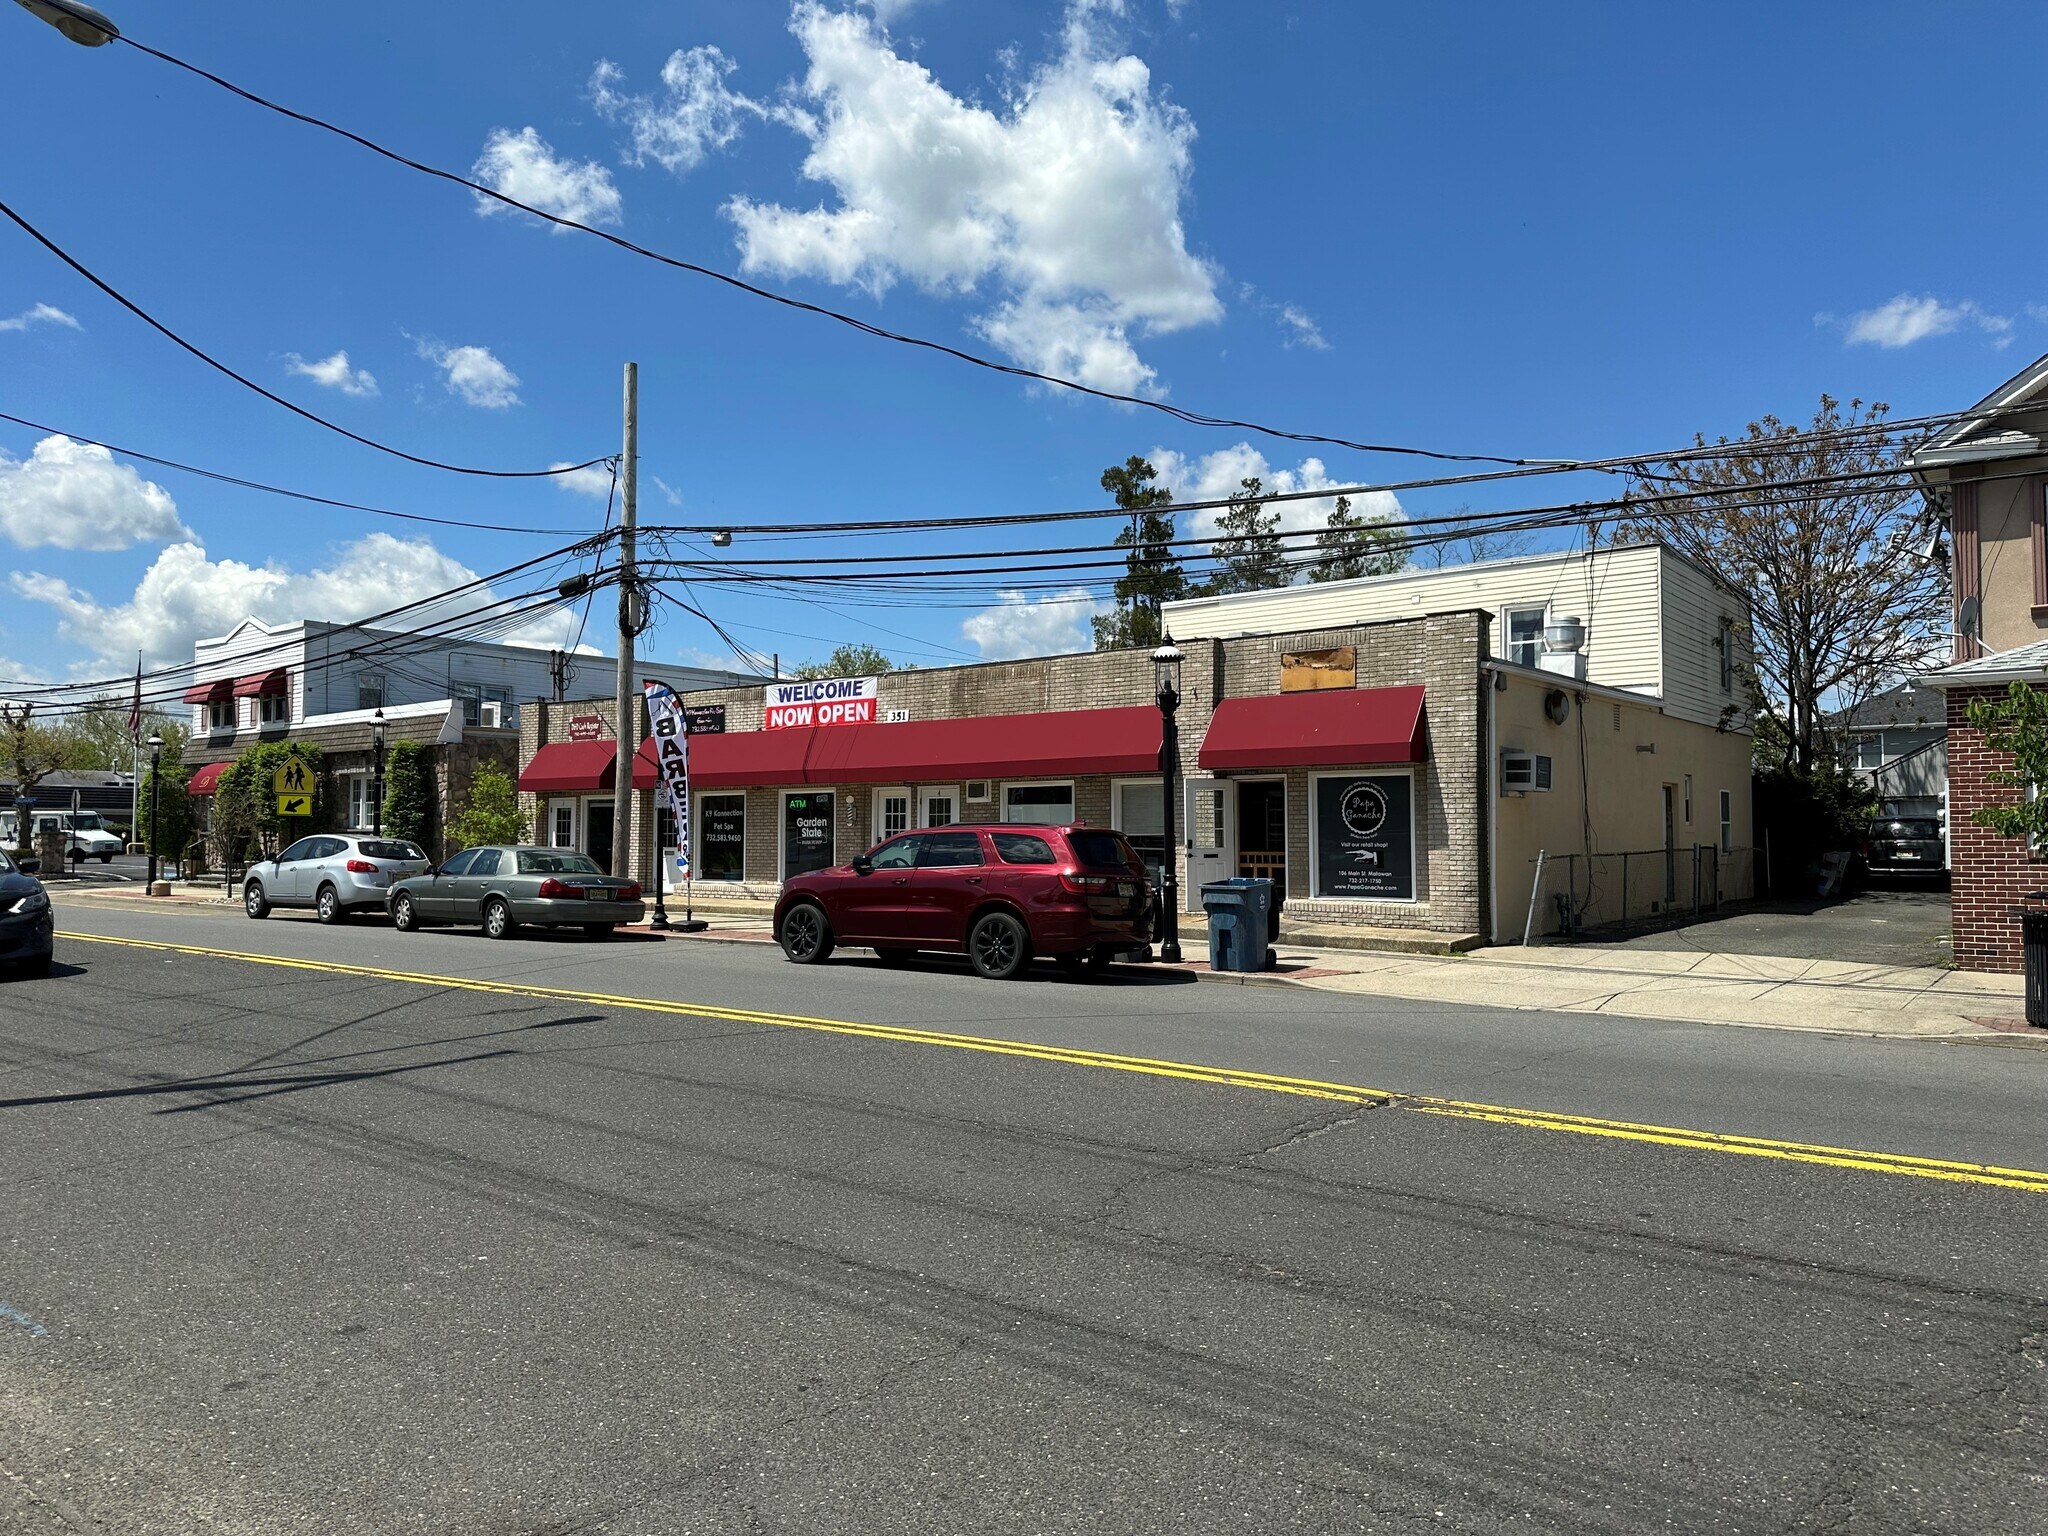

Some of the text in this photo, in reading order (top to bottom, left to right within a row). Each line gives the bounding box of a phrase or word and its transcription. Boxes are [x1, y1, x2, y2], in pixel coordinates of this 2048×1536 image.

[778, 681, 863, 702] WELCOME
[770, 702, 869, 728] NOW OPEN
[892, 712, 906, 722] 351
[790, 800, 806, 808] ATM
[1352, 797, 1375, 811] Papa
[1346, 807, 1381, 821] Ganache
[724, 822, 734, 831] Spa
[796, 817, 827, 827] Garden
[802, 827, 822, 837] State
